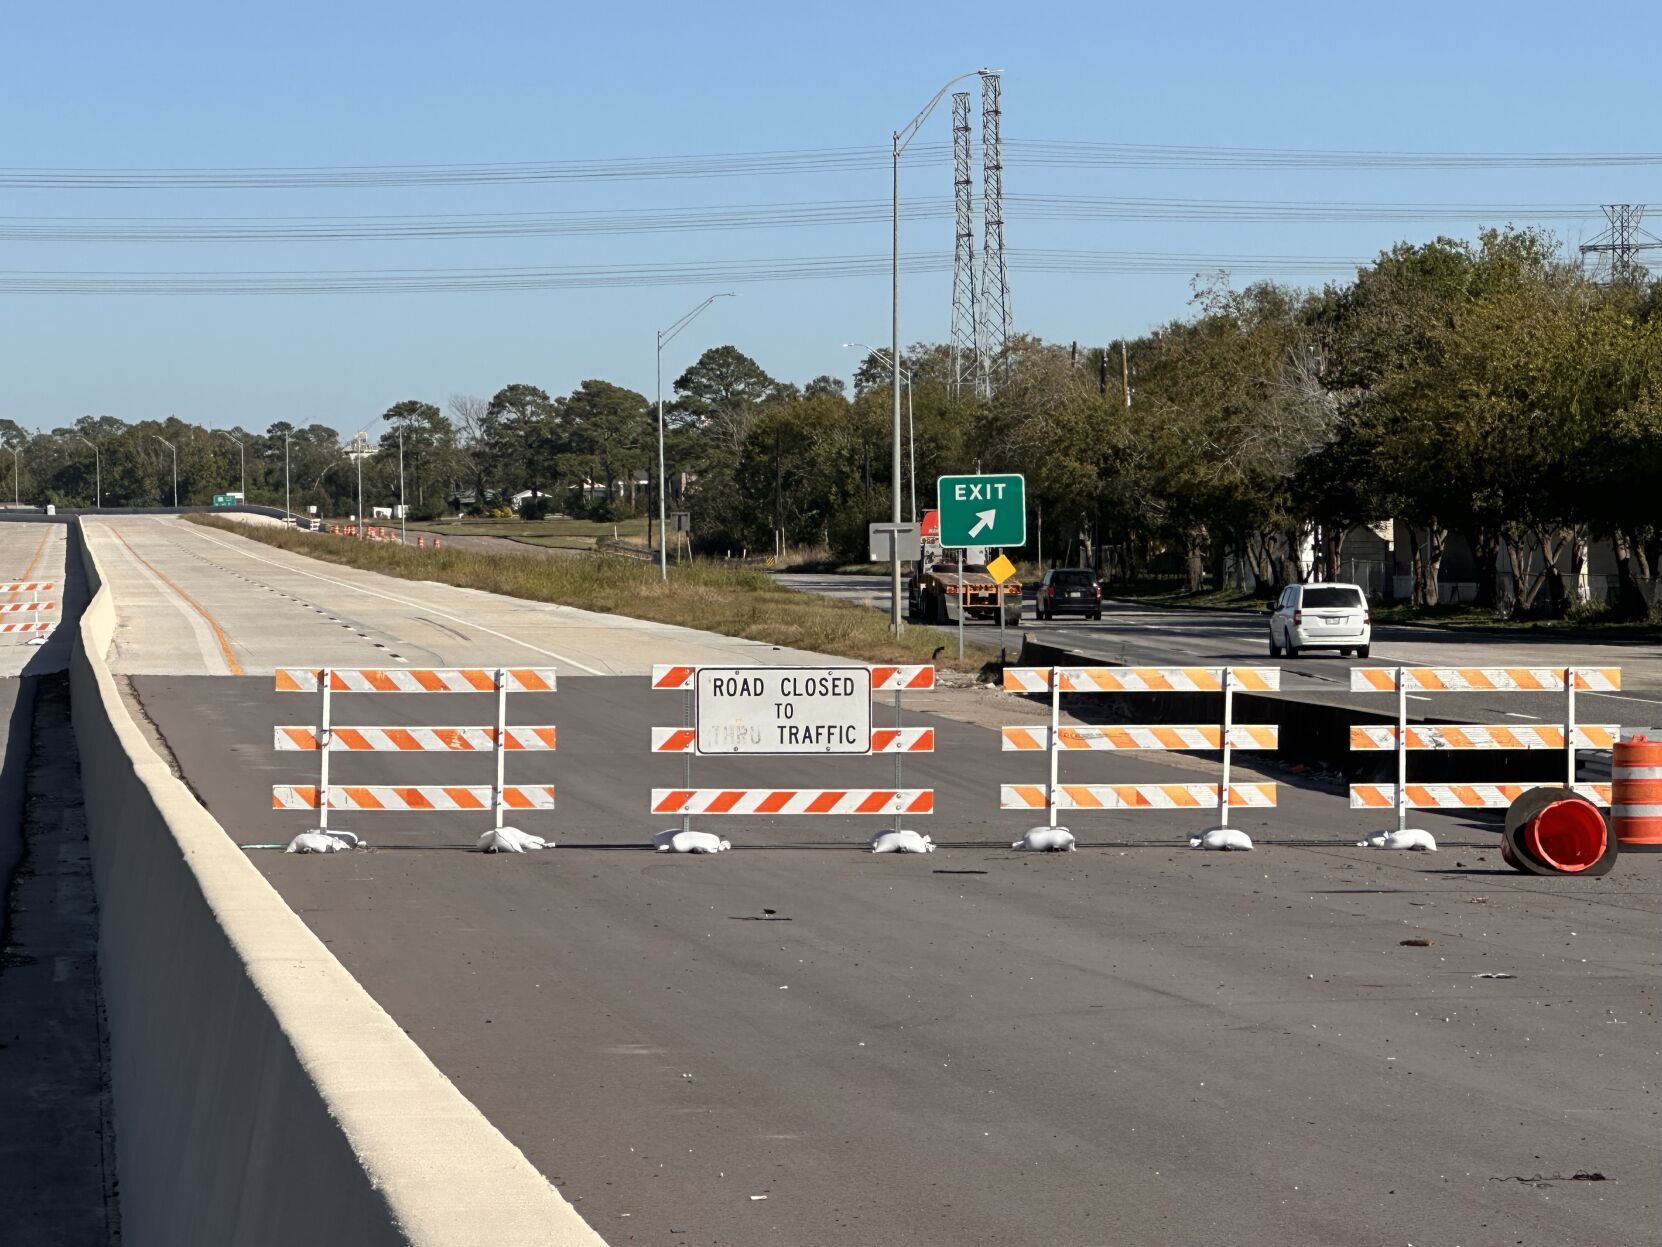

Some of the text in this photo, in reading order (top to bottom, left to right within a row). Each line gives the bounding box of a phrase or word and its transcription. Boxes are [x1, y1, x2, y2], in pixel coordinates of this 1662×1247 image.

[955, 483, 1006, 501] EXIT
[713, 677, 855, 697] ROAD CLOSED
[774, 703, 794, 720] TO
[711, 725, 857, 745] THRU TRAFFIC
